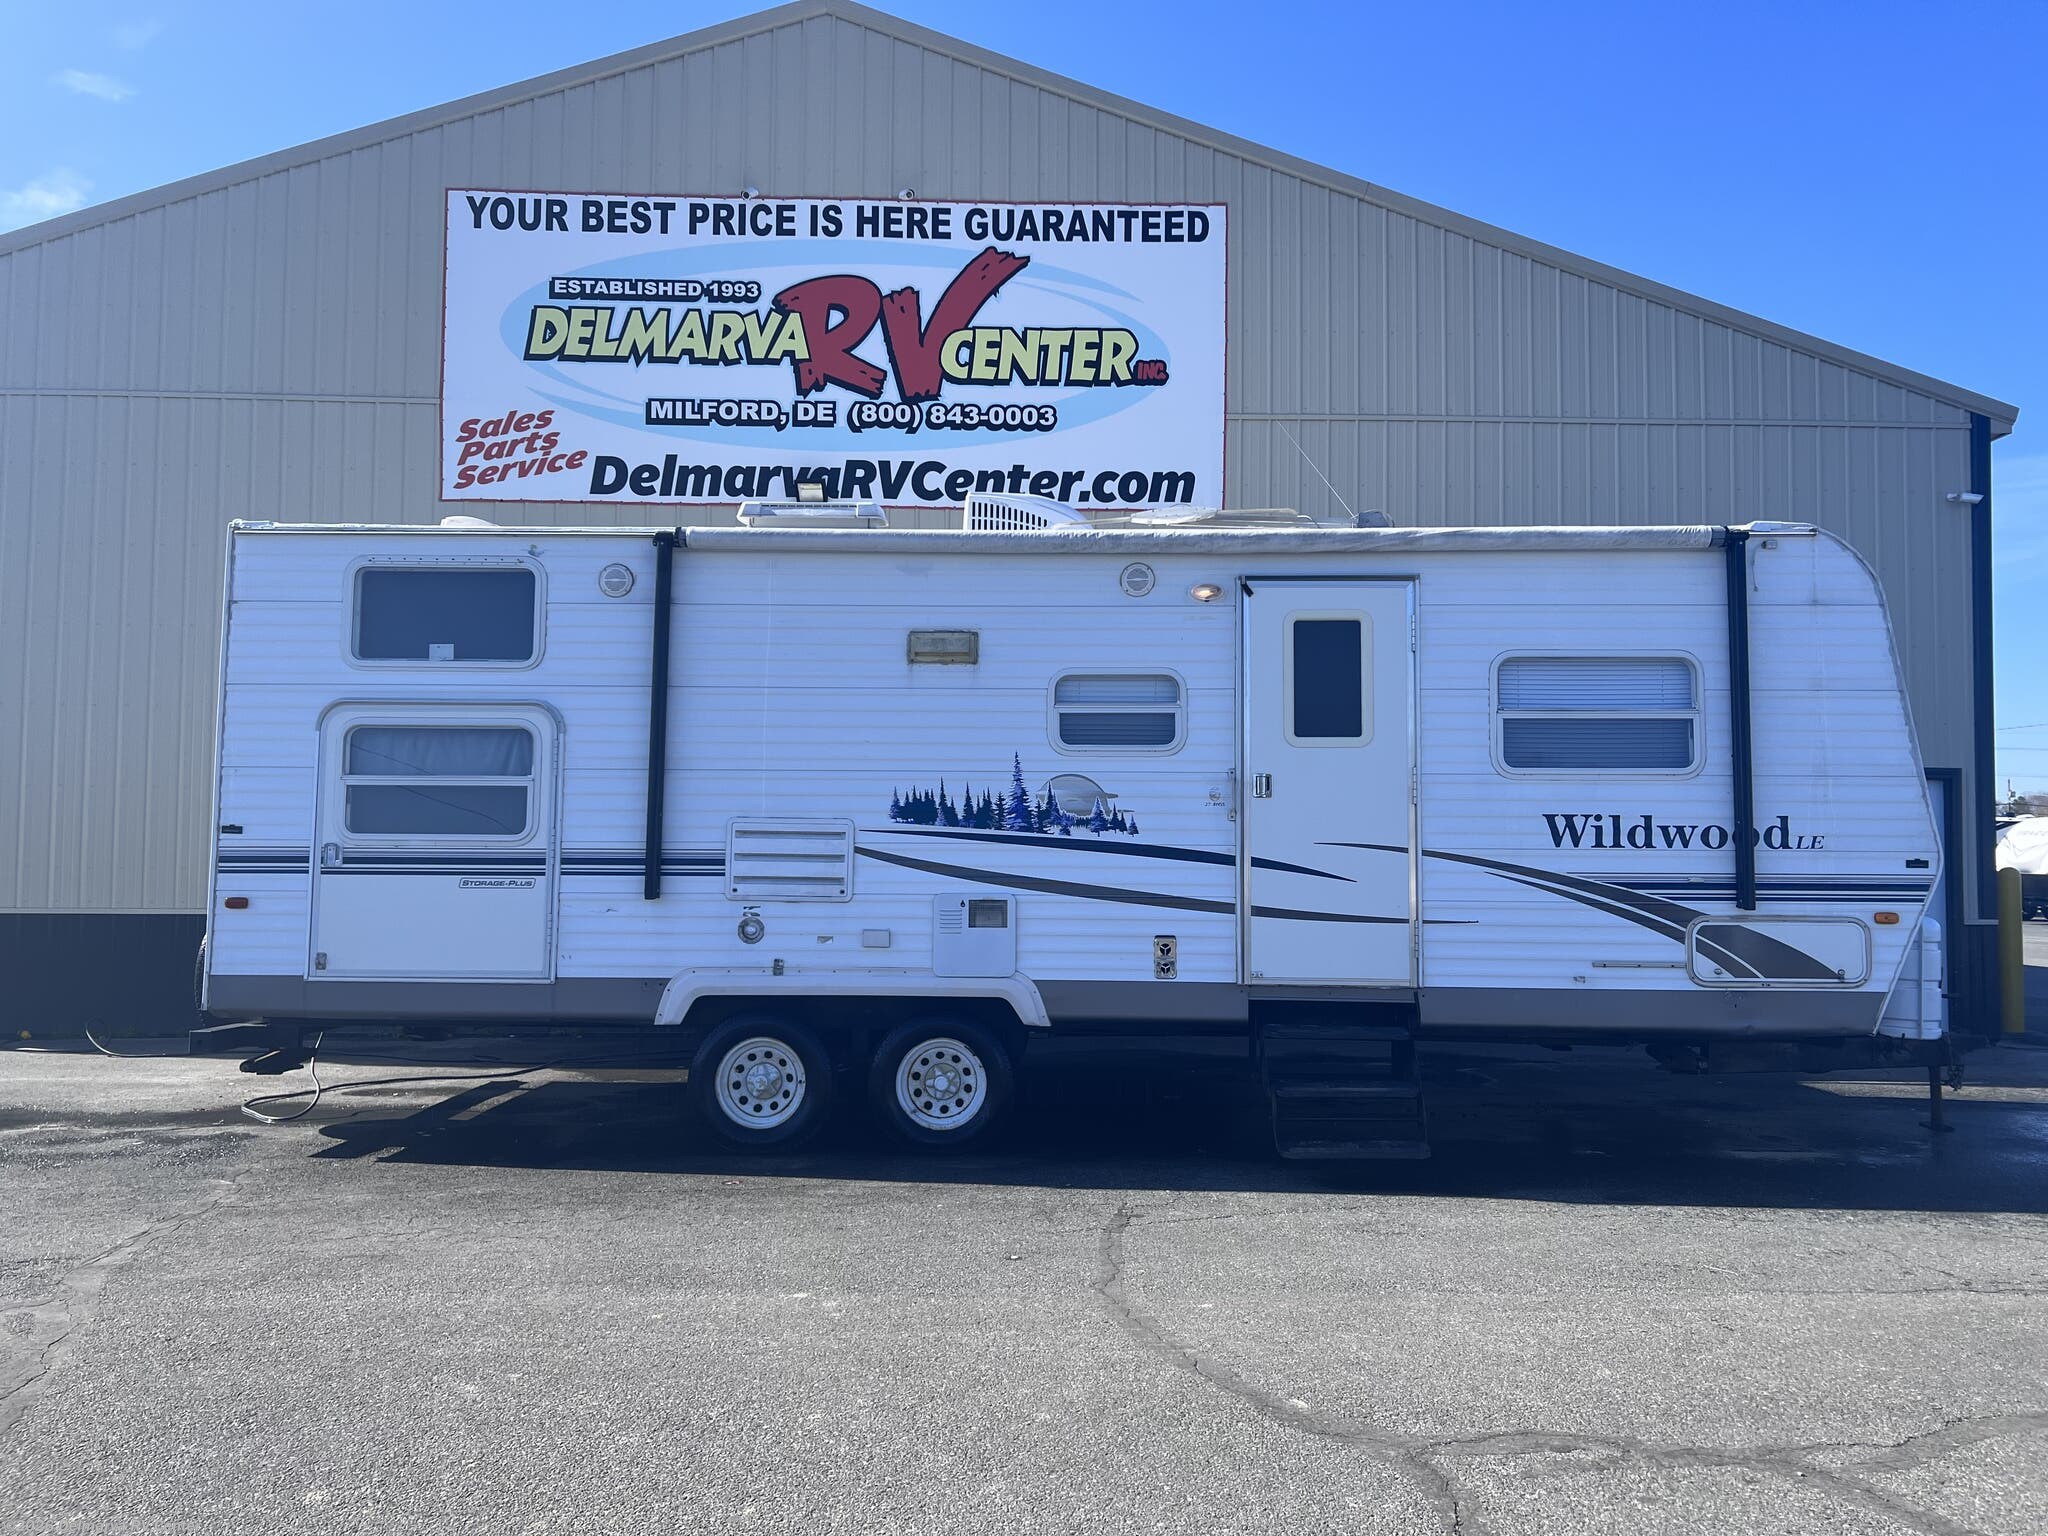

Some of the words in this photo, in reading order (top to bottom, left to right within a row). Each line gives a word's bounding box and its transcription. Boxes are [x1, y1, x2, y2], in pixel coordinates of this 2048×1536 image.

[466, 195, 569, 231] YOUR
[581, 199, 676, 235] BEST
[688, 203, 796, 237] PRICE
[810, 204, 843, 237] IS
[856, 205, 952, 240] HERE
[964, 208, 1210, 242] GUARANTEED
[552, 278, 702, 298] ESTABLISHED
[707, 281, 760, 299] 1993
[525, 305, 811, 363] DELMARVA
[771, 246, 1030, 402] RV
[940, 327, 1138, 384] CENTER
[455, 409, 555, 442] Sales
[649, 400, 788, 424] MILFORD,
[796, 402, 835, 423] DE
[851, 403, 921, 428] (800)
[929, 404, 1057, 427] 843-0003
[456, 431, 561, 465] Parts
[453, 450, 588, 489] Service
[589, 454, 1197, 503] DelmarvaRVCenter.com
[1794, 835, 1825, 850] LE
